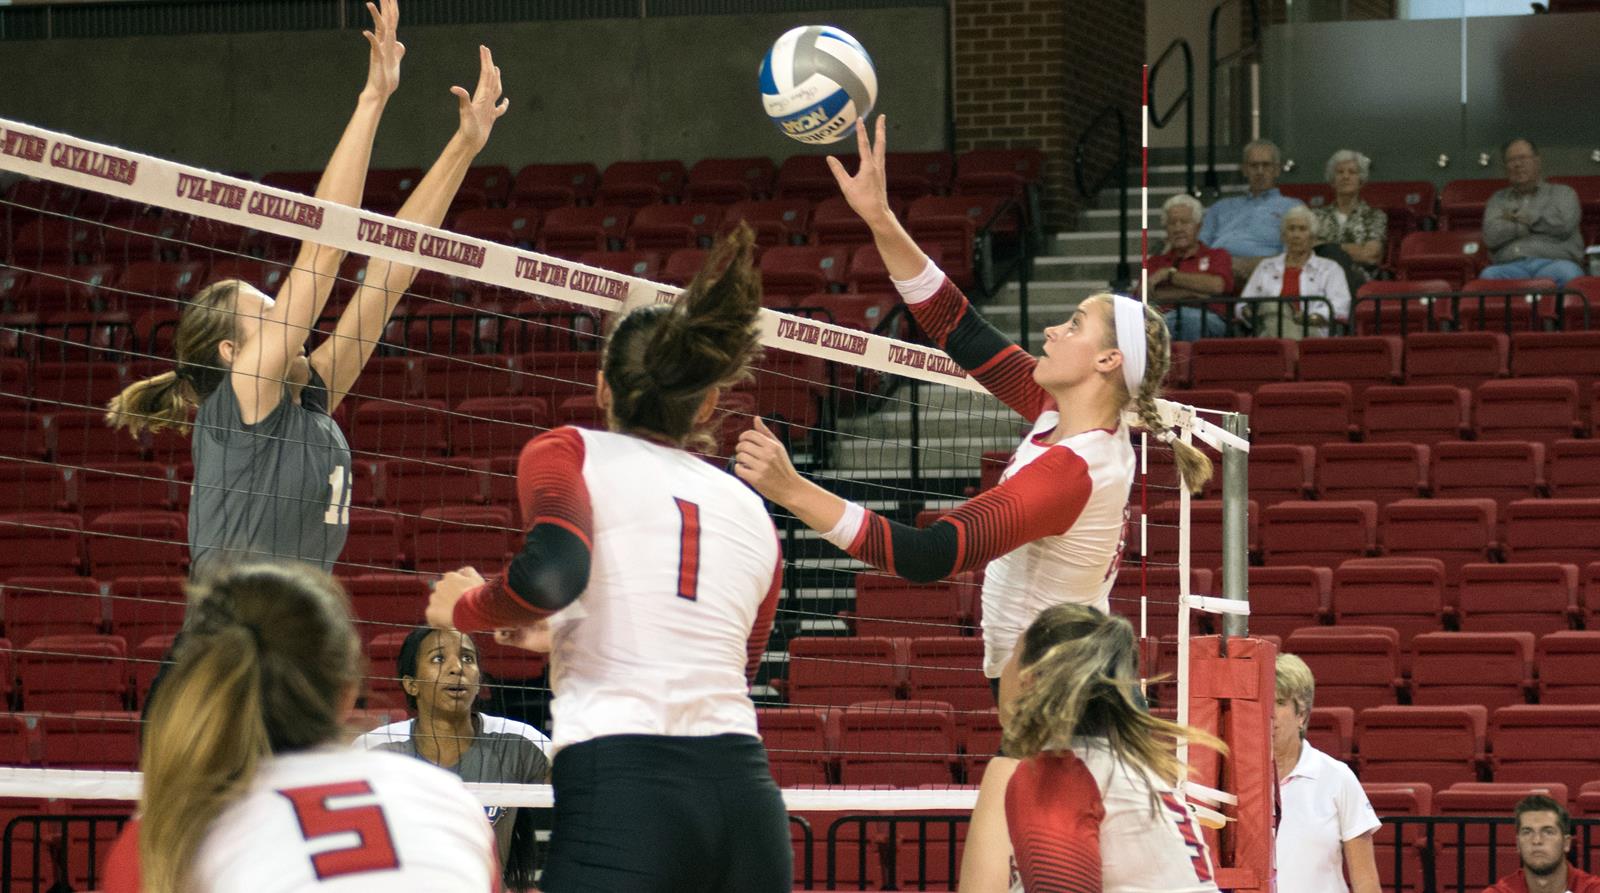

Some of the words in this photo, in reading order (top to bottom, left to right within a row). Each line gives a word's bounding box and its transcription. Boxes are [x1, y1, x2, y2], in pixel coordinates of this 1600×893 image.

[781, 107, 829, 134] NCAA
[50, 142, 138, 186] CAVALIERS
[247, 190, 325, 230] CAVALIERS
[419, 233, 486, 269] CAVALIERS
[569, 271, 630, 301] CAVALIERS
[821, 328, 869, 356] CAVALIERS
[672, 495, 702, 602] 1
[273, 779, 401, 881] 5
